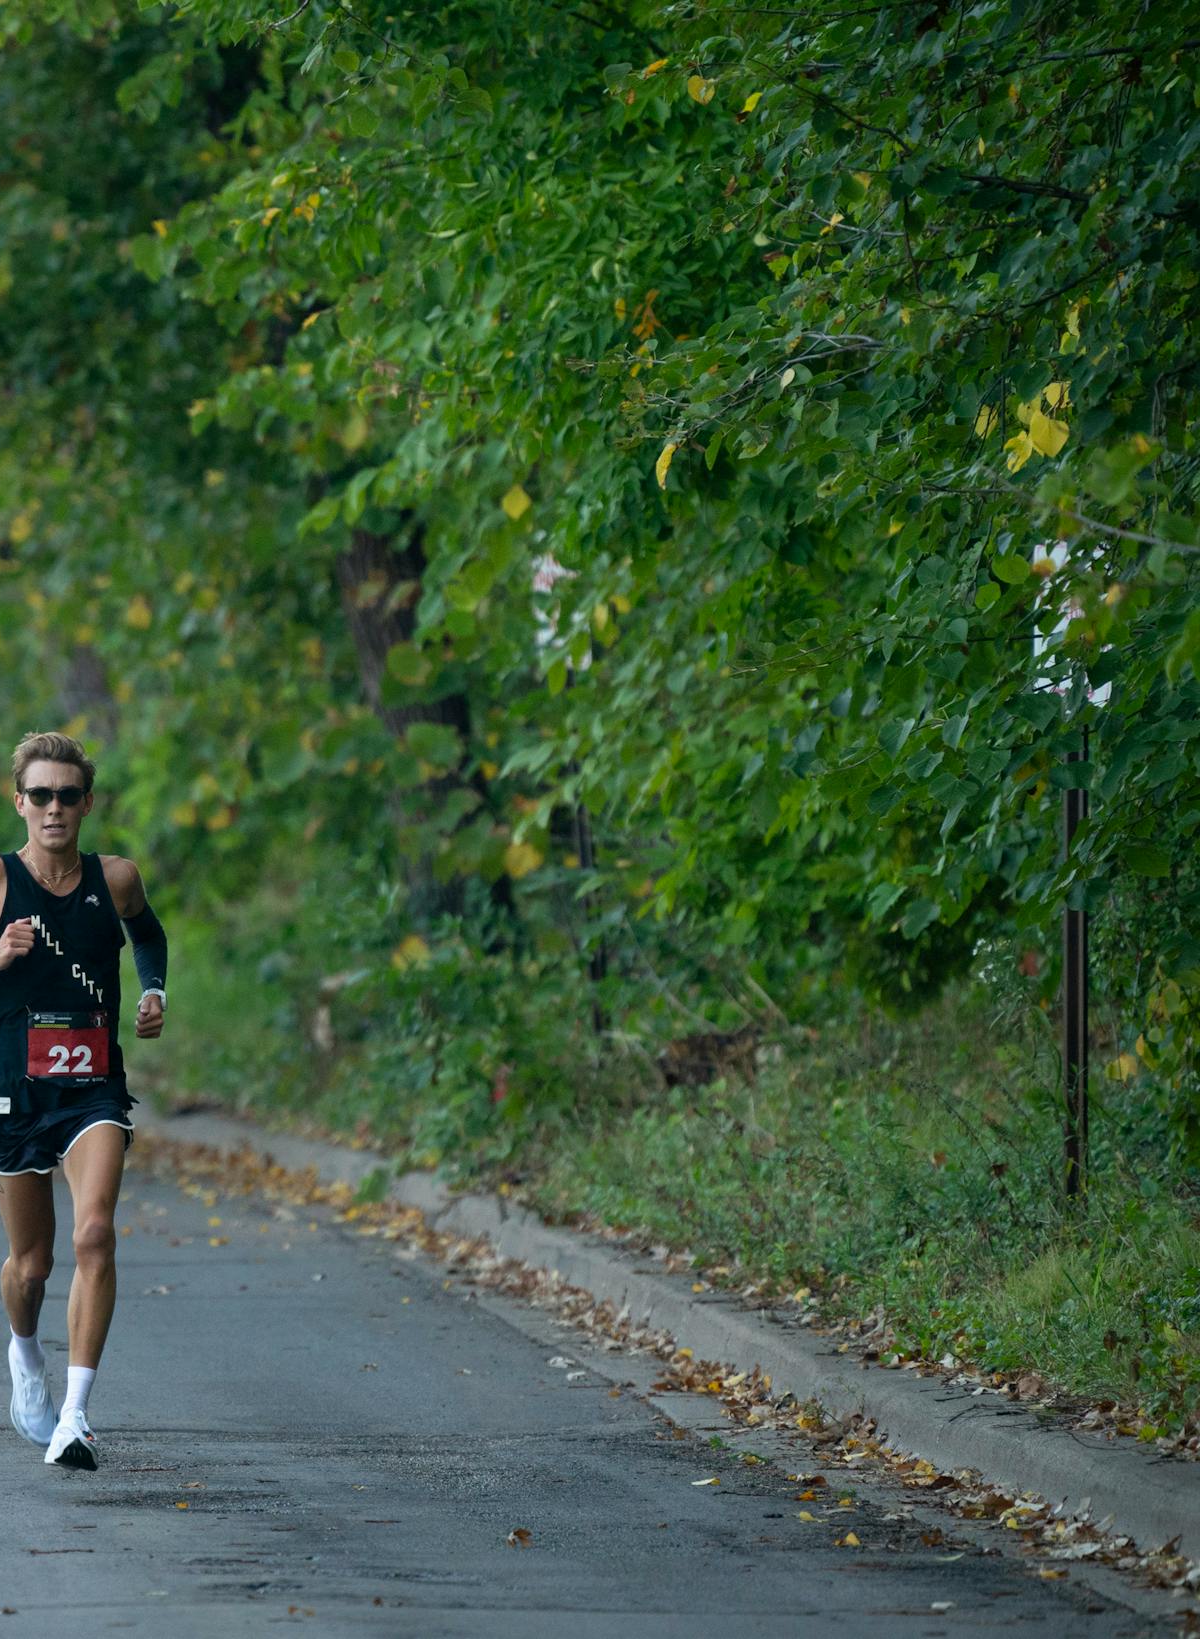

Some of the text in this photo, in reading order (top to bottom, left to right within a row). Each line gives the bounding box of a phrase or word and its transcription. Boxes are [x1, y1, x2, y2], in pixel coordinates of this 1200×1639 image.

[31, 915, 103, 1003] MILL CITY
[47, 1044, 93, 1074] 22
